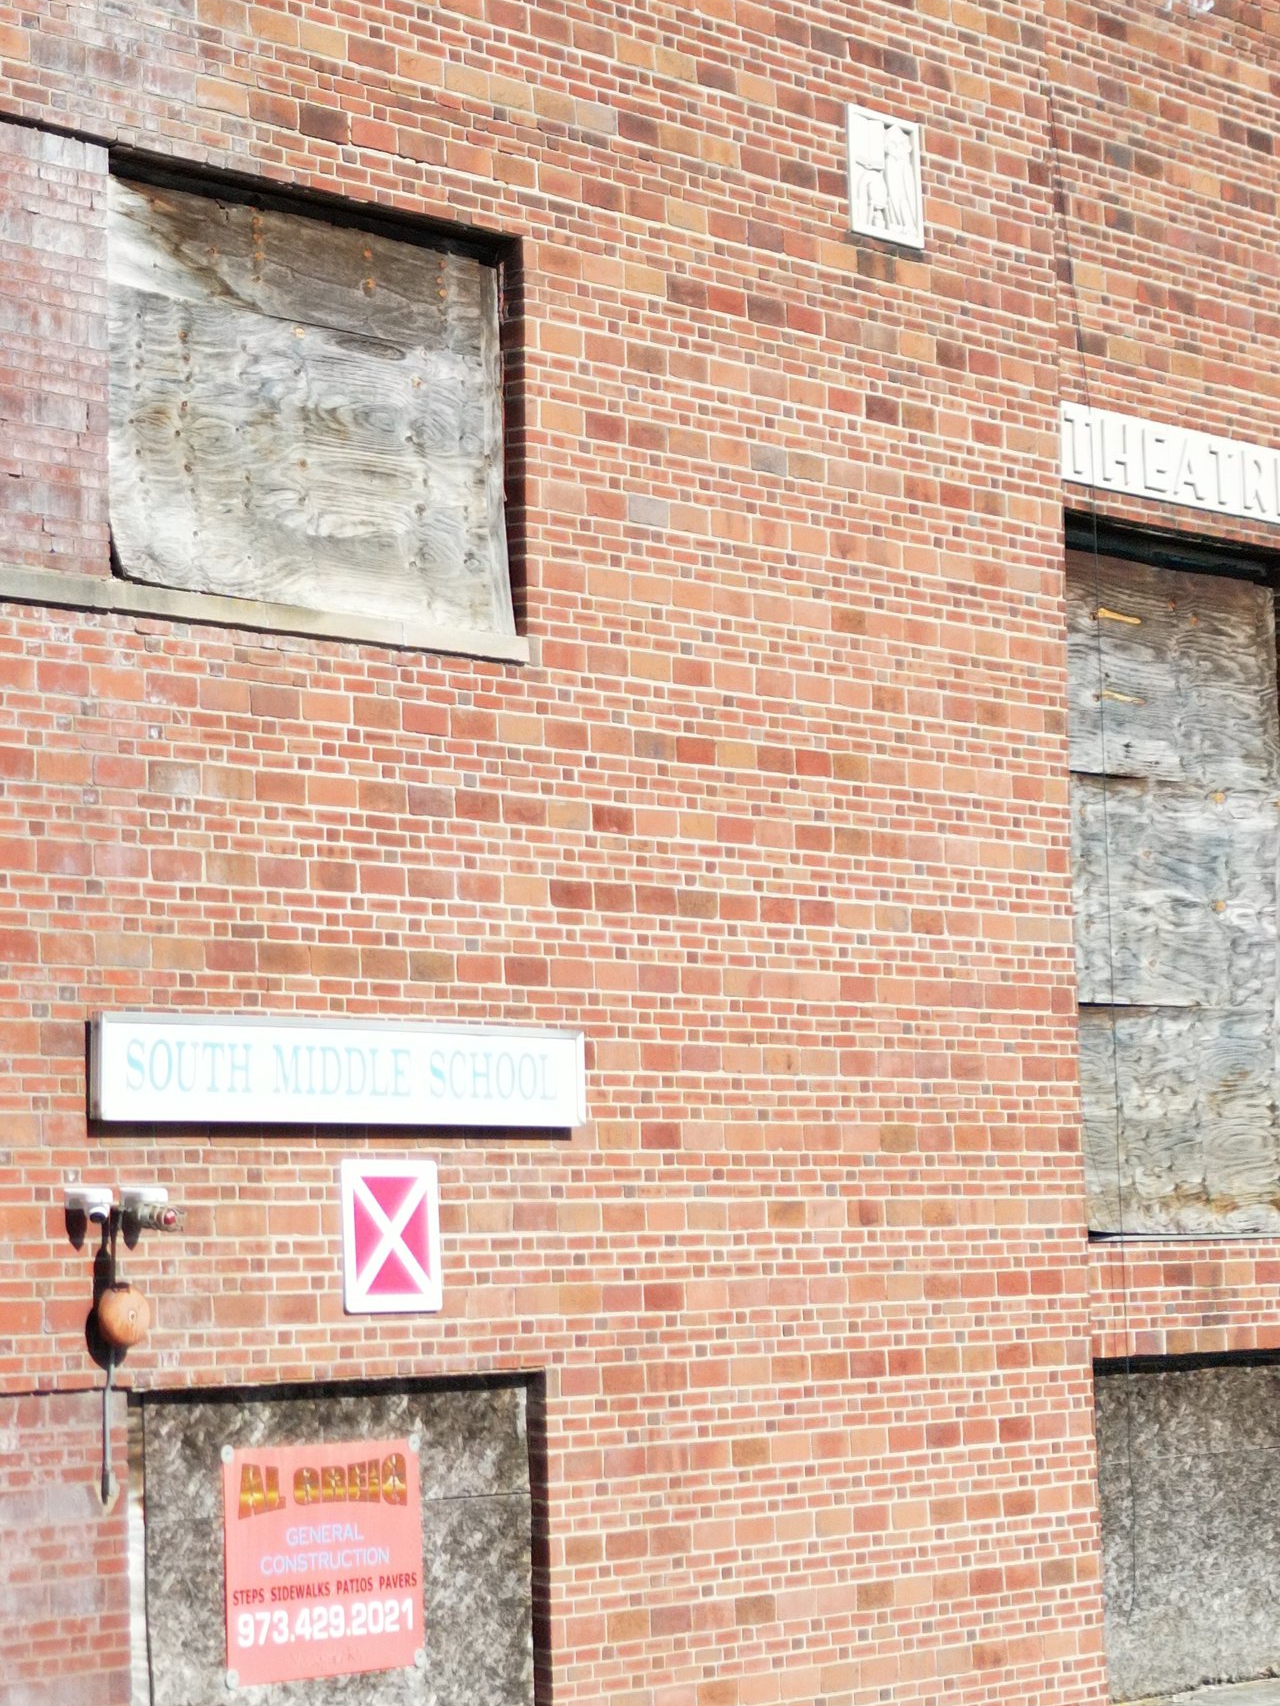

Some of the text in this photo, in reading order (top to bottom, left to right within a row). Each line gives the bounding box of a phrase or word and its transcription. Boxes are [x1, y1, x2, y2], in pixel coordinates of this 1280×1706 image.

[1062, 408, 1280, 517] THEATR
[125, 1037, 557, 1101] SOUTH MIDDLE SCHOOL
[238, 1462, 286, 1520] AL
[286, 1523, 365, 1546] GENERAL
[259, 1547, 390, 1576] CONSTRUCTION
[232, 1572, 417, 1606] STEPS SIDEWALKS PATIOS PAVERS
[237, 1597, 414, 1649] 973.429.2021
